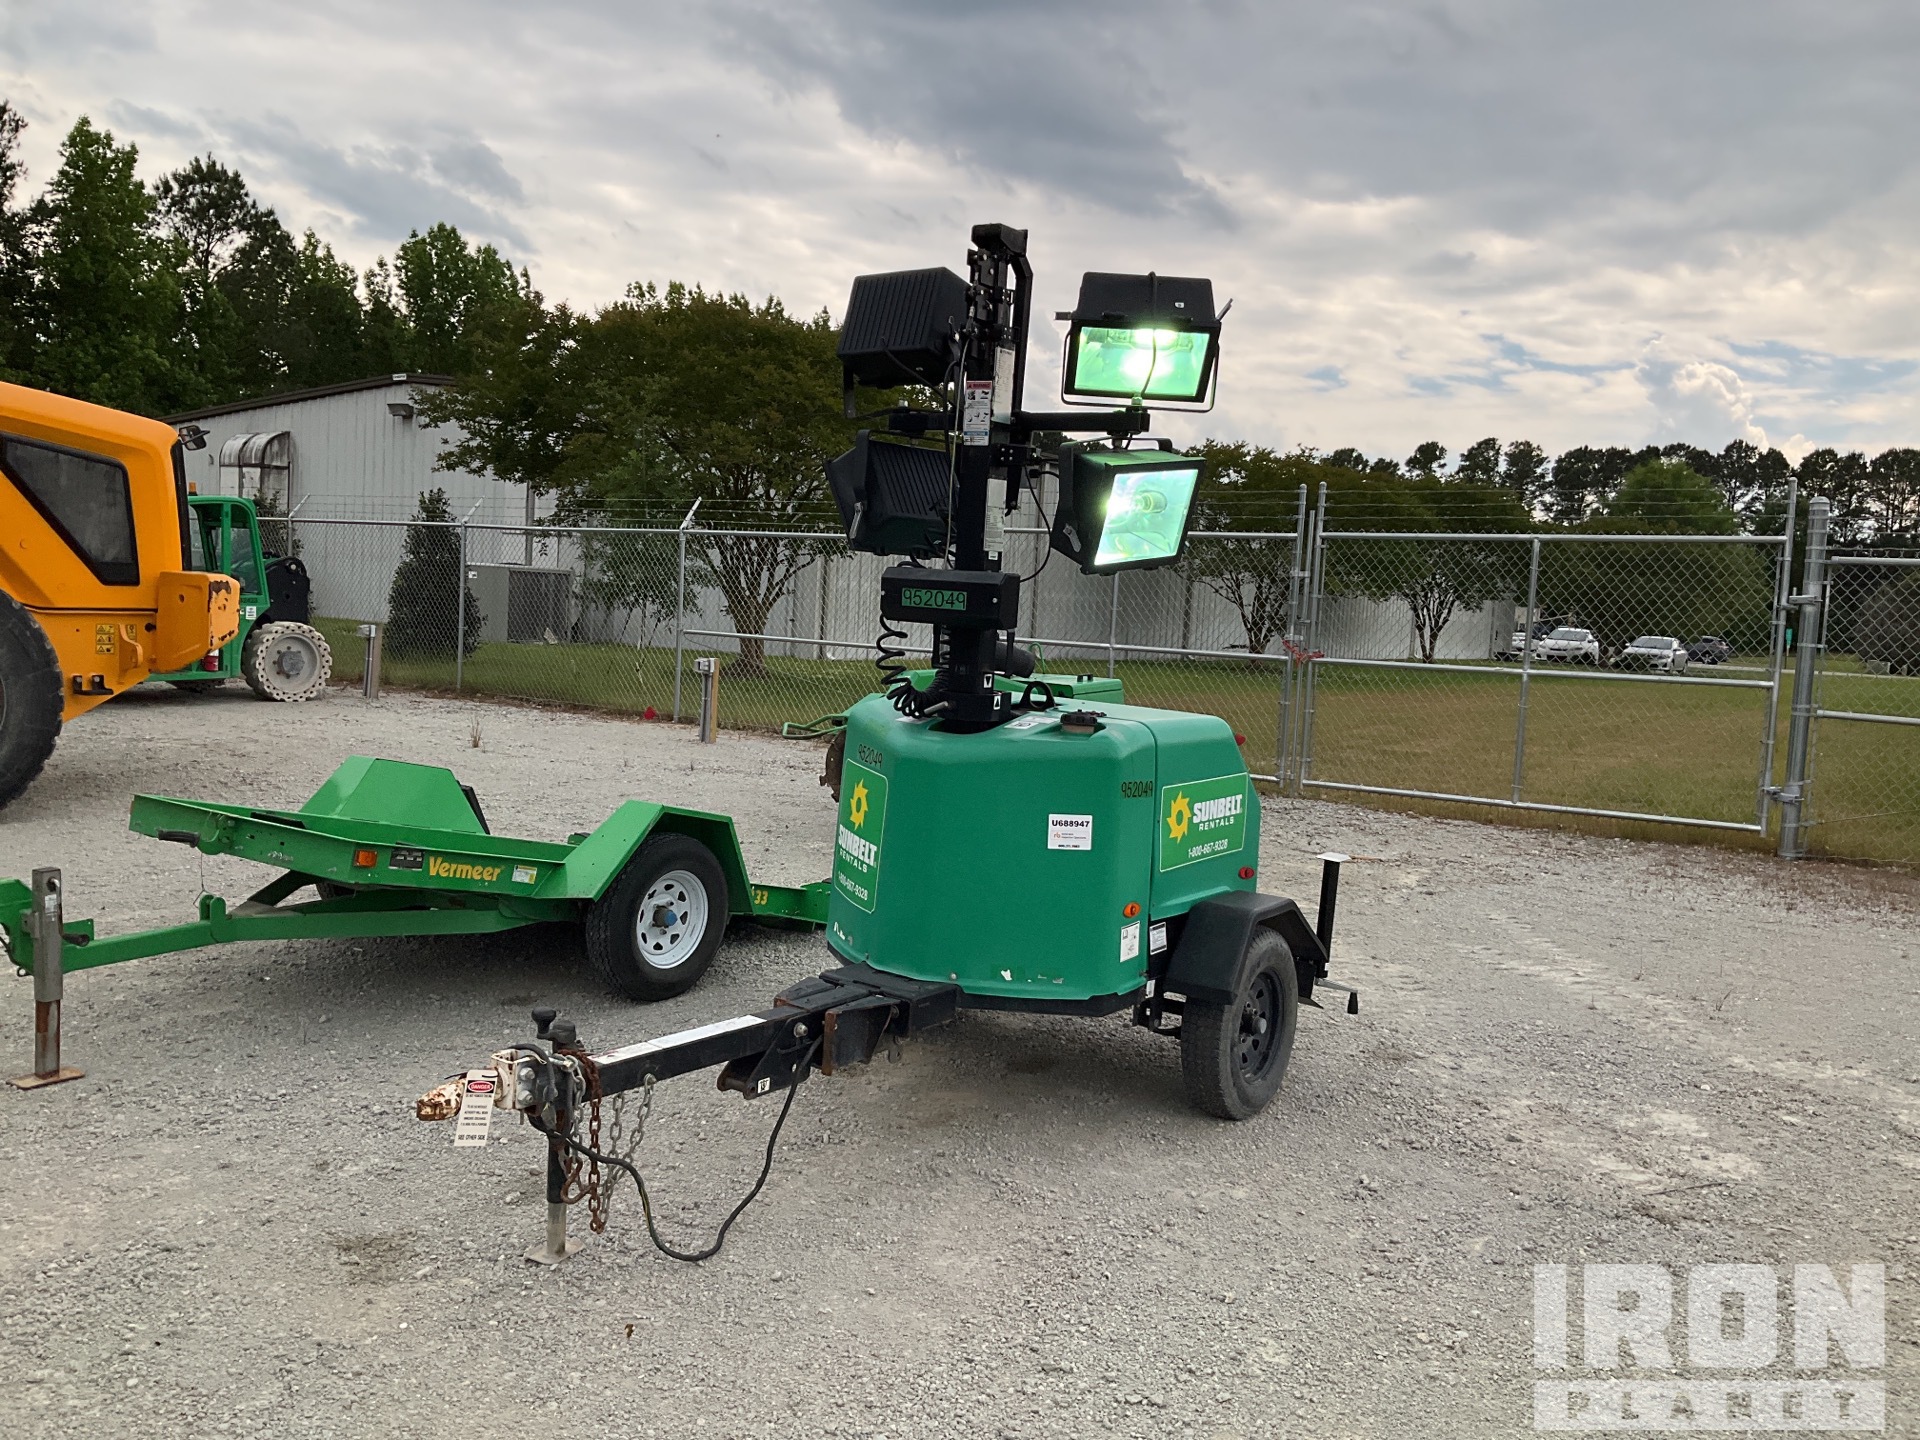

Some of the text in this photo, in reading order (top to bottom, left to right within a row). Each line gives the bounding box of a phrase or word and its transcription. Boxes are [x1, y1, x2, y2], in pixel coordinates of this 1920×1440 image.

[903, 589, 966, 610] 952049
[858, 743, 883, 769] 952049
[1121, 780, 1153, 799] 952049
[1193, 794, 1243, 824] SUNBELT
[1051, 819, 1090, 828] U688947
[1199, 816, 1234, 831] RENTALS
[838, 823, 878, 867] SUNBELT
[429, 855, 501, 882] Vermeer
[839, 848, 868, 873] RENTALS
